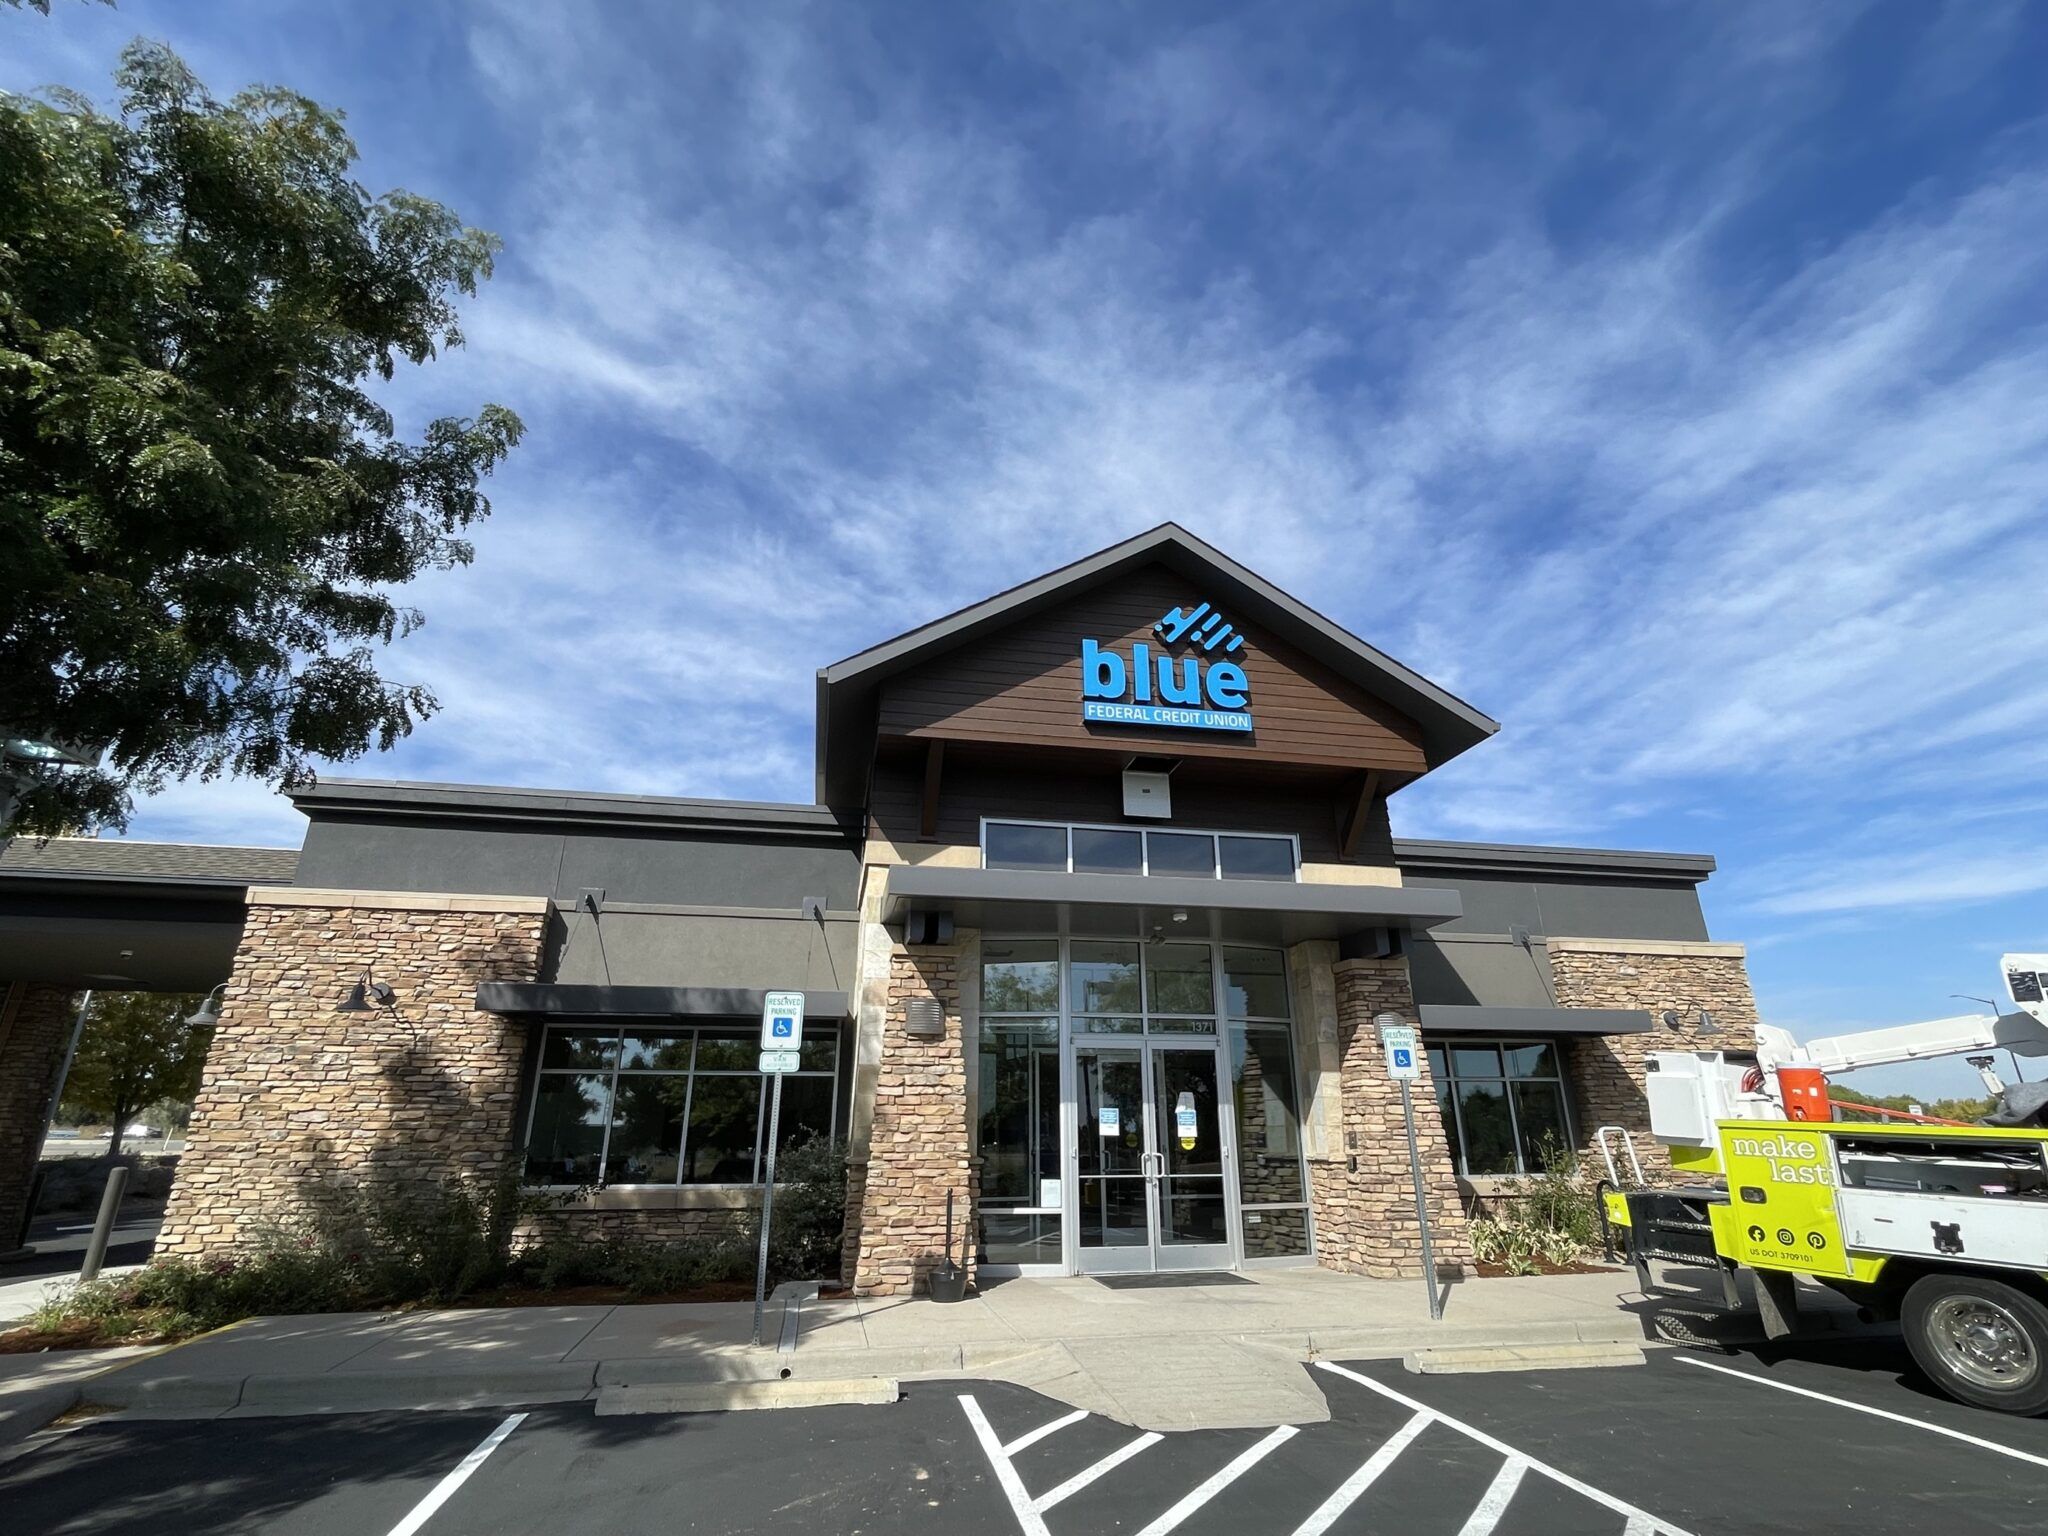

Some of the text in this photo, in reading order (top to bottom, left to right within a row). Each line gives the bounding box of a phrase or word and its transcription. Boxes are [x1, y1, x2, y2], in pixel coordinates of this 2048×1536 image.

[1082, 638, 1248, 708] blue
[1088, 704, 1248, 728] FEDERAL CREDIT UNION
[768, 998, 800, 1006] RESERVED
[771, 1007, 797, 1015] PARKING
[1191, 1021, 1213, 1032] 1371
[1731, 1134, 1816, 1159] make
[1749, 1248, 1760, 1256] US
